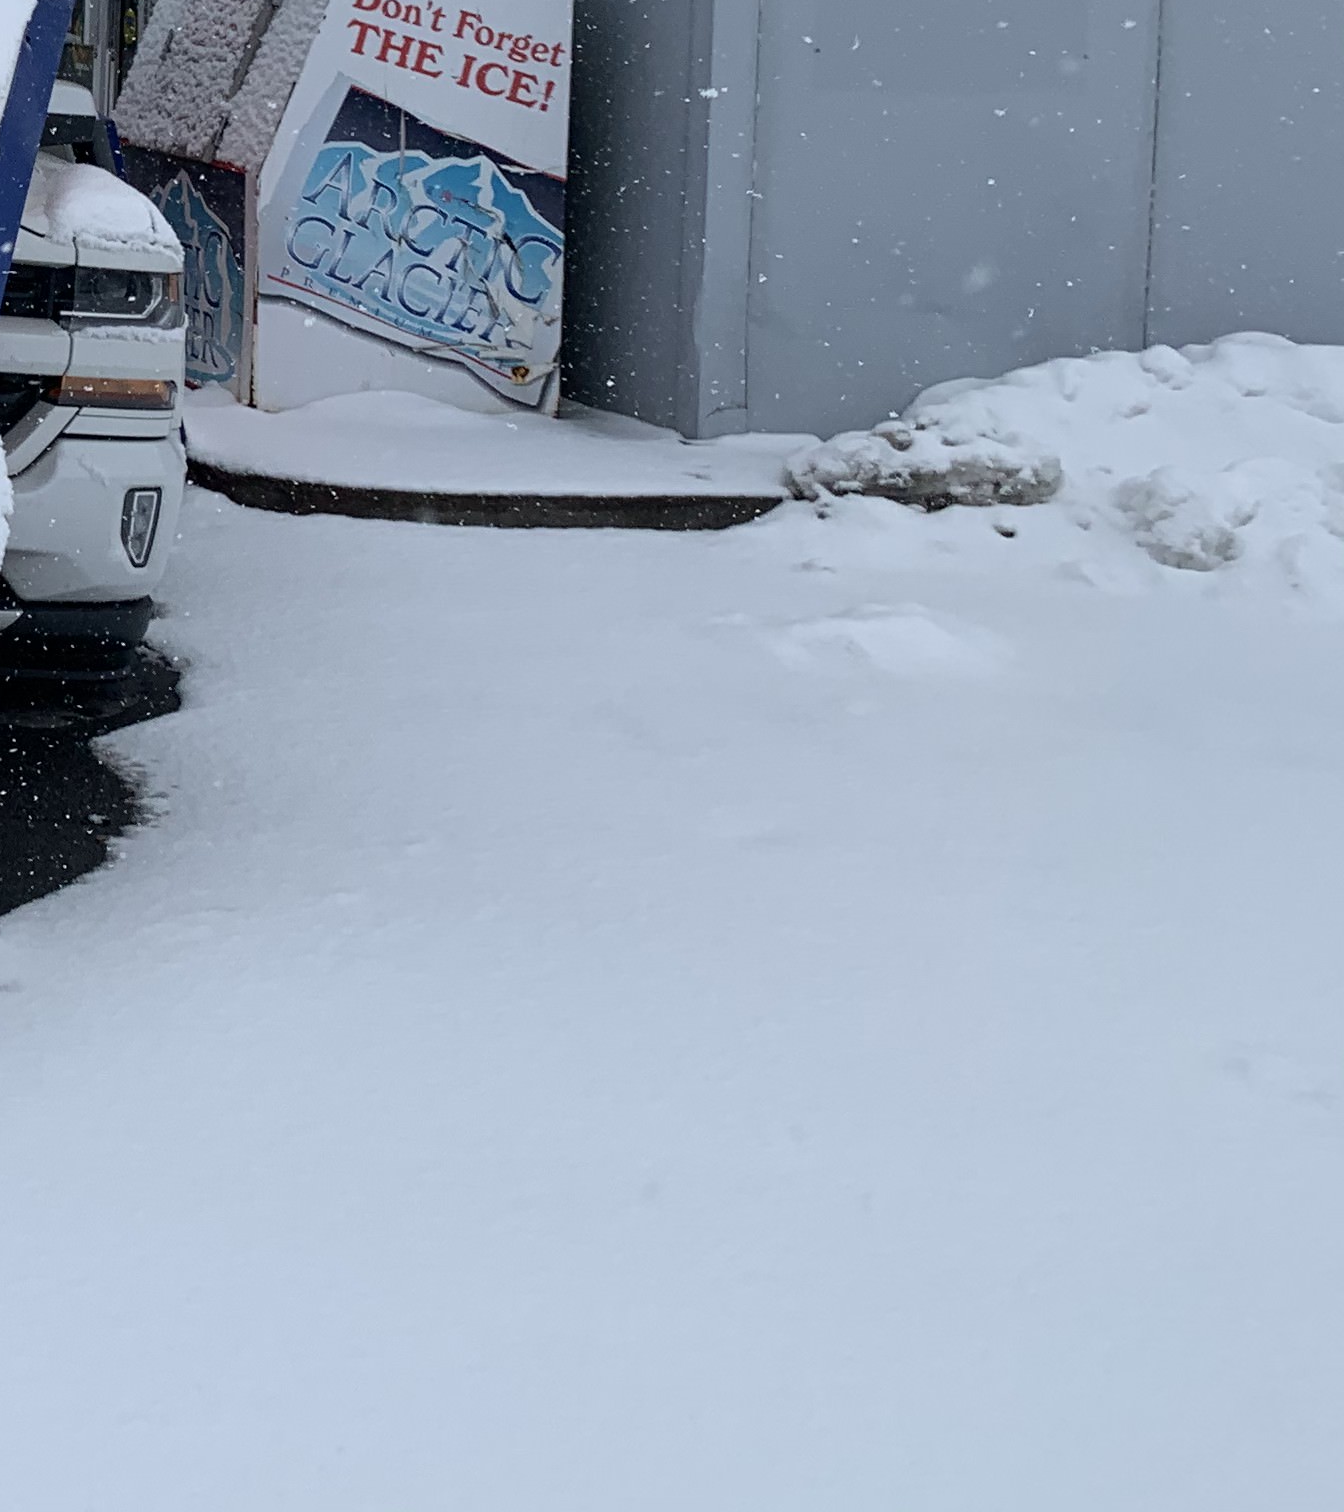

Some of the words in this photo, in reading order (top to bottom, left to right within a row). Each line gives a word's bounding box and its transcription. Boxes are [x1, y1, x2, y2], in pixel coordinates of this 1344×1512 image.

[346, 18, 445, 79] THE
[455, 53, 556, 112] ICE!
[452, 9, 566, 67] Forget
[285, 215, 517, 350] GLACIER
[302, 152, 563, 305] ARCTIC
